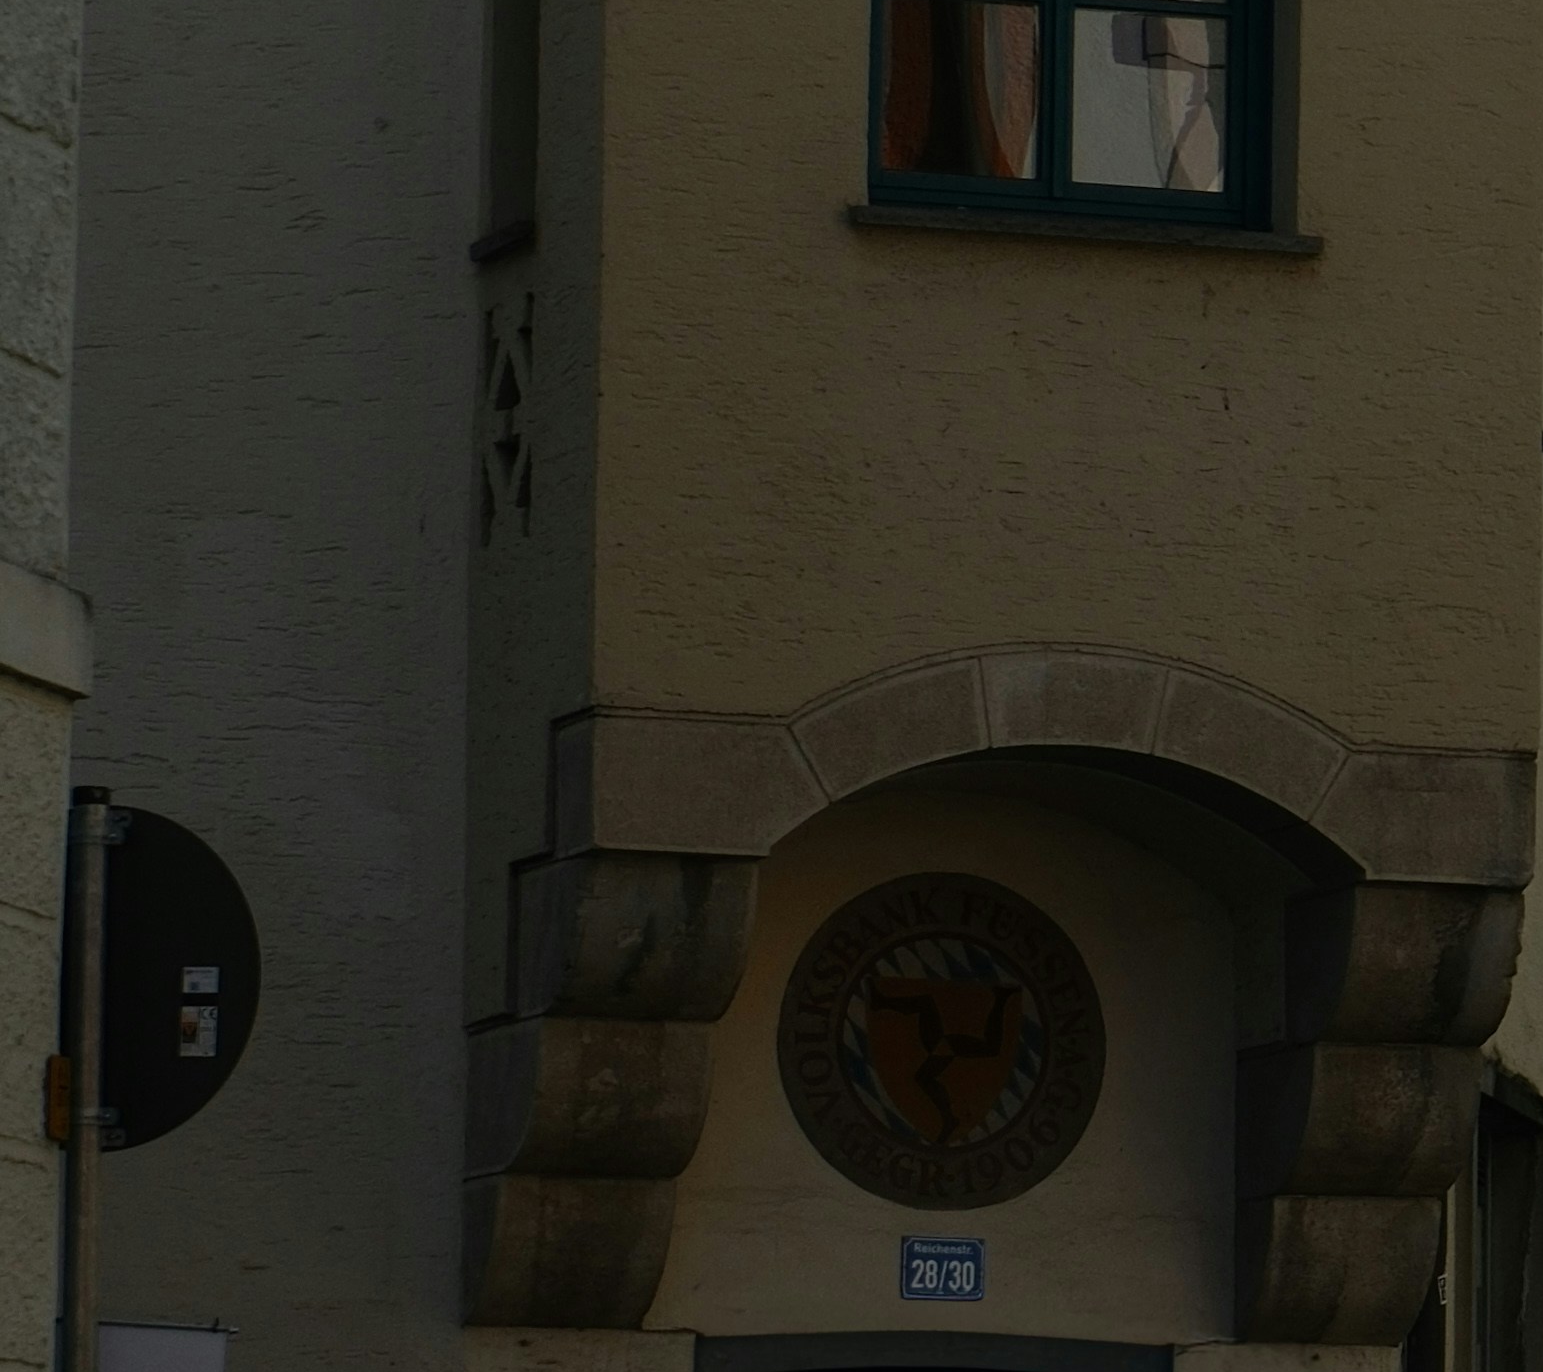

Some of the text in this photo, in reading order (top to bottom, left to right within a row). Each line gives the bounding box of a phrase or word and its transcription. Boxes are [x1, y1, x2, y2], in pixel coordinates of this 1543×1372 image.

[795, 885, 943, 1124] VOLKSBANK
[913, 1241, 975, 1256] Reichenstr.
[911, 1259, 976, 1293] 28/30
